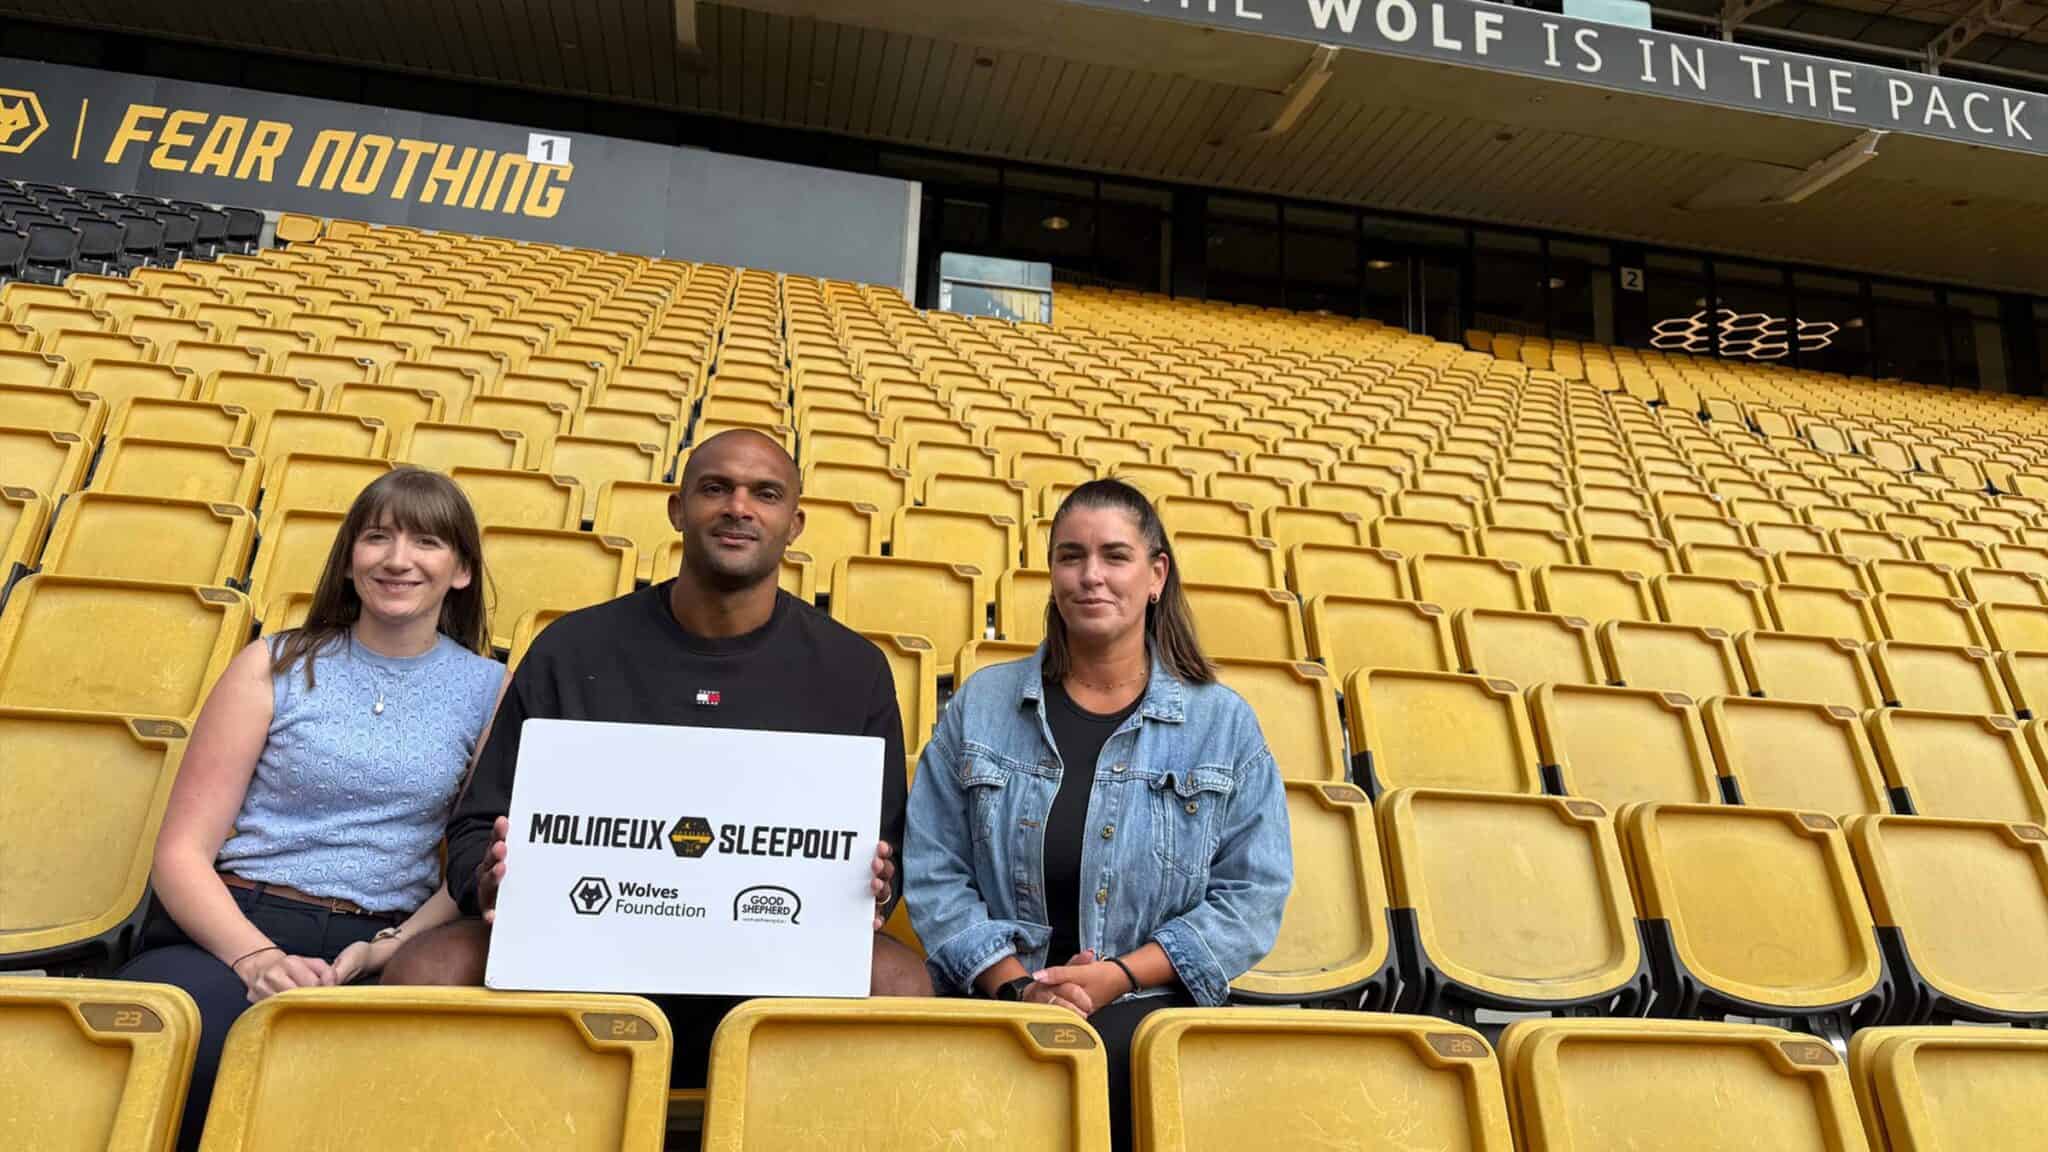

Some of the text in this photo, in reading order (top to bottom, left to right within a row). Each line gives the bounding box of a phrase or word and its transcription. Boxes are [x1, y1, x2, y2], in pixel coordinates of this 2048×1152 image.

[1308, 0, 2033, 141] WOLF IS IN THE PACK
[540, 139, 555, 161] 1
[103, 104, 574, 218] FEAR NOTHING
[1627, 271, 1640, 288] 2
[529, 813, 858, 861] MOLINEUX SLEEPOUT
[618, 882, 679, 899] Wolves
[615, 899, 706, 918] Foundation
[750, 895, 785, 906] GOOD
[741, 904, 791, 915] SHEPHERD
[113, 1011, 143, 1027] 23
[612, 1019, 638, 1035] 24
[1054, 1028, 1077, 1043] 25
[1450, 1039, 1473, 1053] 26
